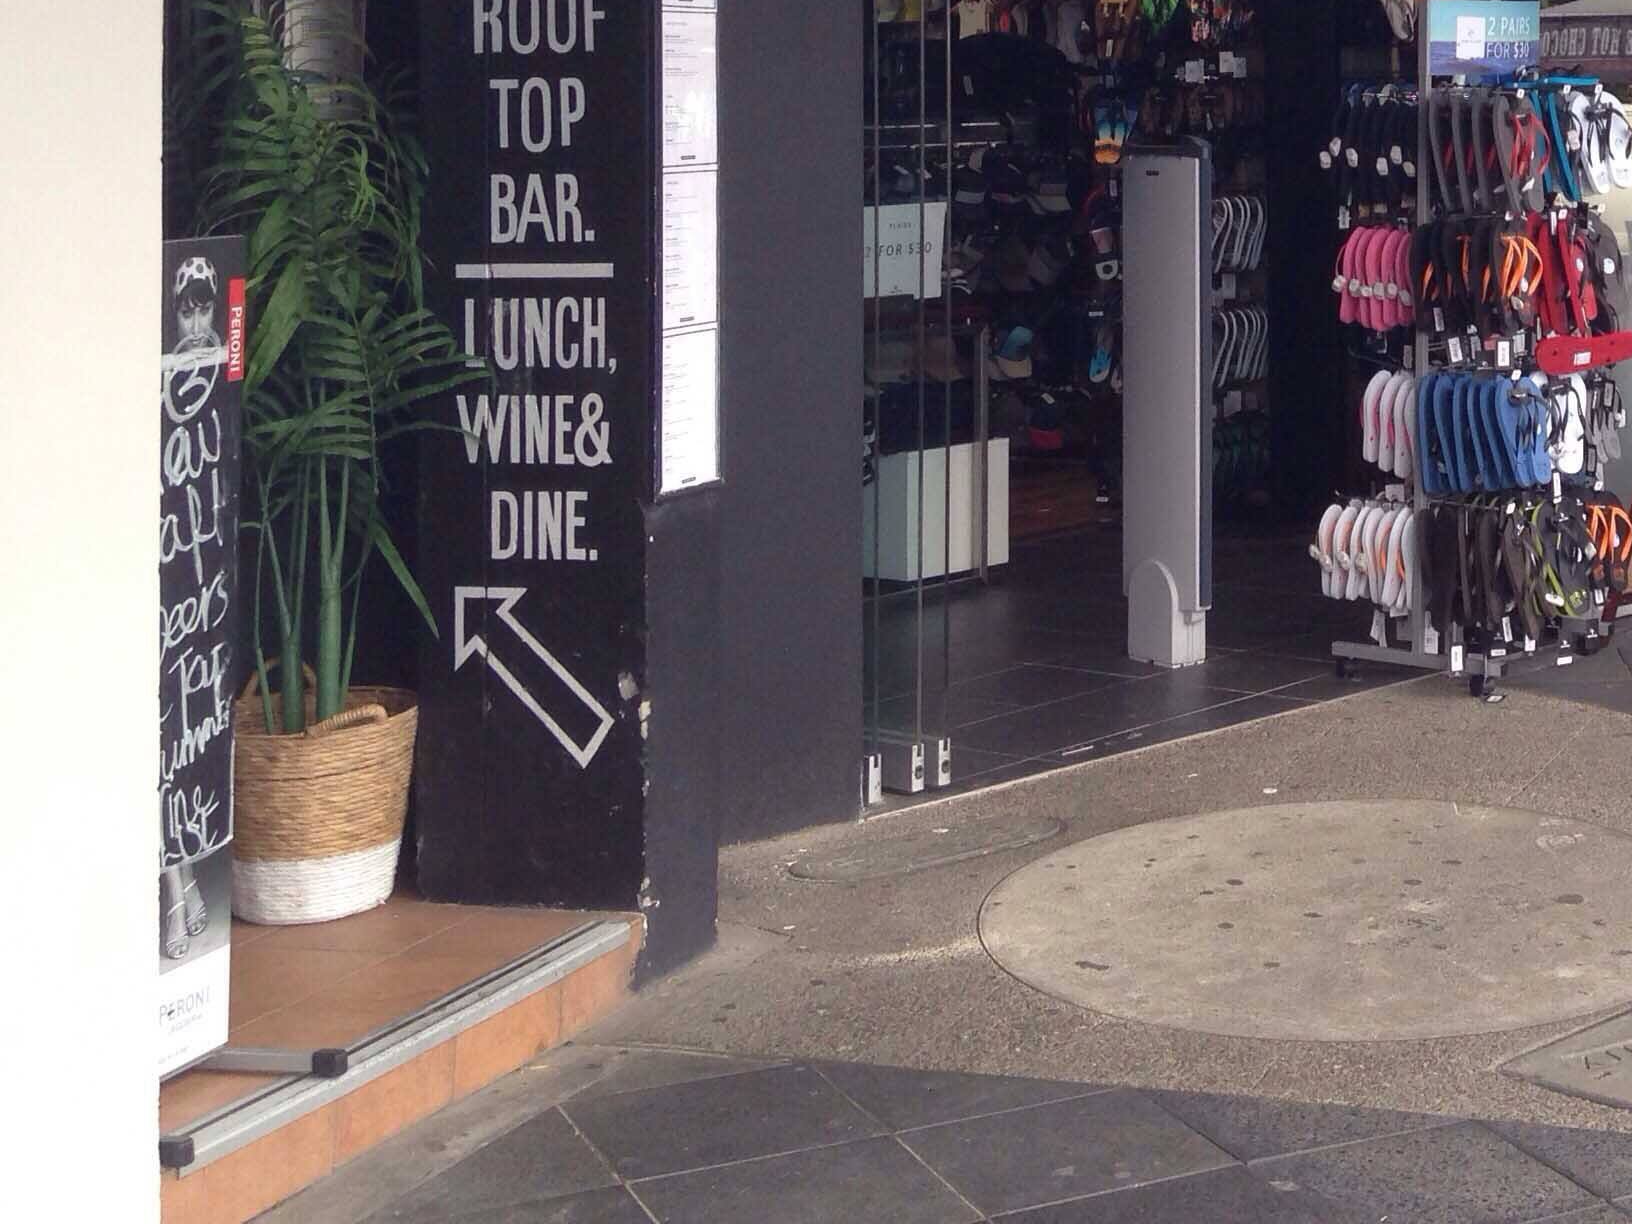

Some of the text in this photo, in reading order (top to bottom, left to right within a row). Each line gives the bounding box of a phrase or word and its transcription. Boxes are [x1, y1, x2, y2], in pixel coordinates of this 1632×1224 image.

[1486, 41, 1530, 58] FOR $30
[1487, 15, 1531, 36] 2 PAIRS
[489, 77, 587, 154] TOP
[489, 173, 596, 244] BAR.
[231, 304, 244, 374] PERONI
[463, 296, 618, 375] LUNCH,
[489, 490, 599, 561] DINE.
[159, 984, 211, 1028] PERONI
